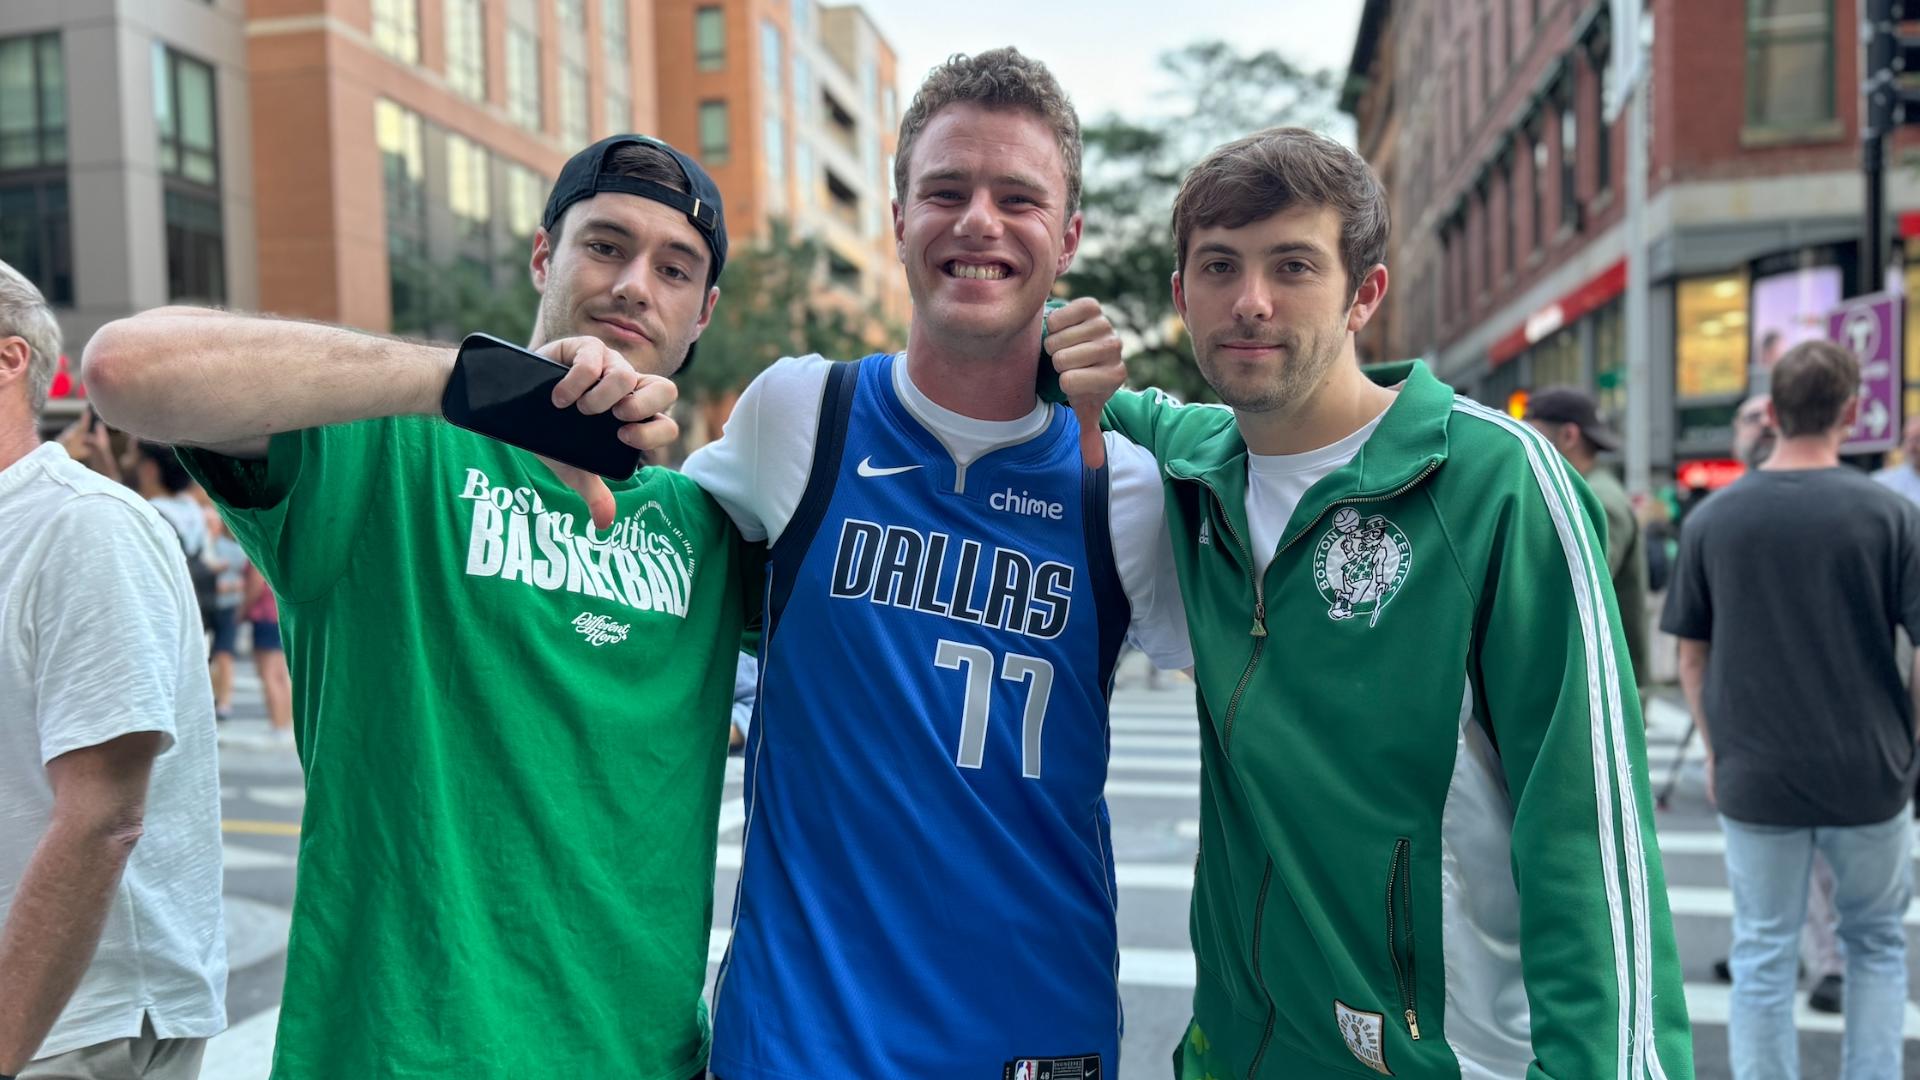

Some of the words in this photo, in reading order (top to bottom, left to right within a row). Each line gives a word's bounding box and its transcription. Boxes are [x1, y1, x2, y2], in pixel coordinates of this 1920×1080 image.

[458, 468, 575, 539] Bostn
[586, 516, 677, 555] Celtics
[989, 488, 1064, 520] chime
[829, 518, 1075, 640] DALLAS
[1315, 531, 1339, 591] BOSTON
[1387, 533, 1410, 593] CELTICS
[571, 611, 631, 634] Different
[934, 638, 1054, 780] 77
